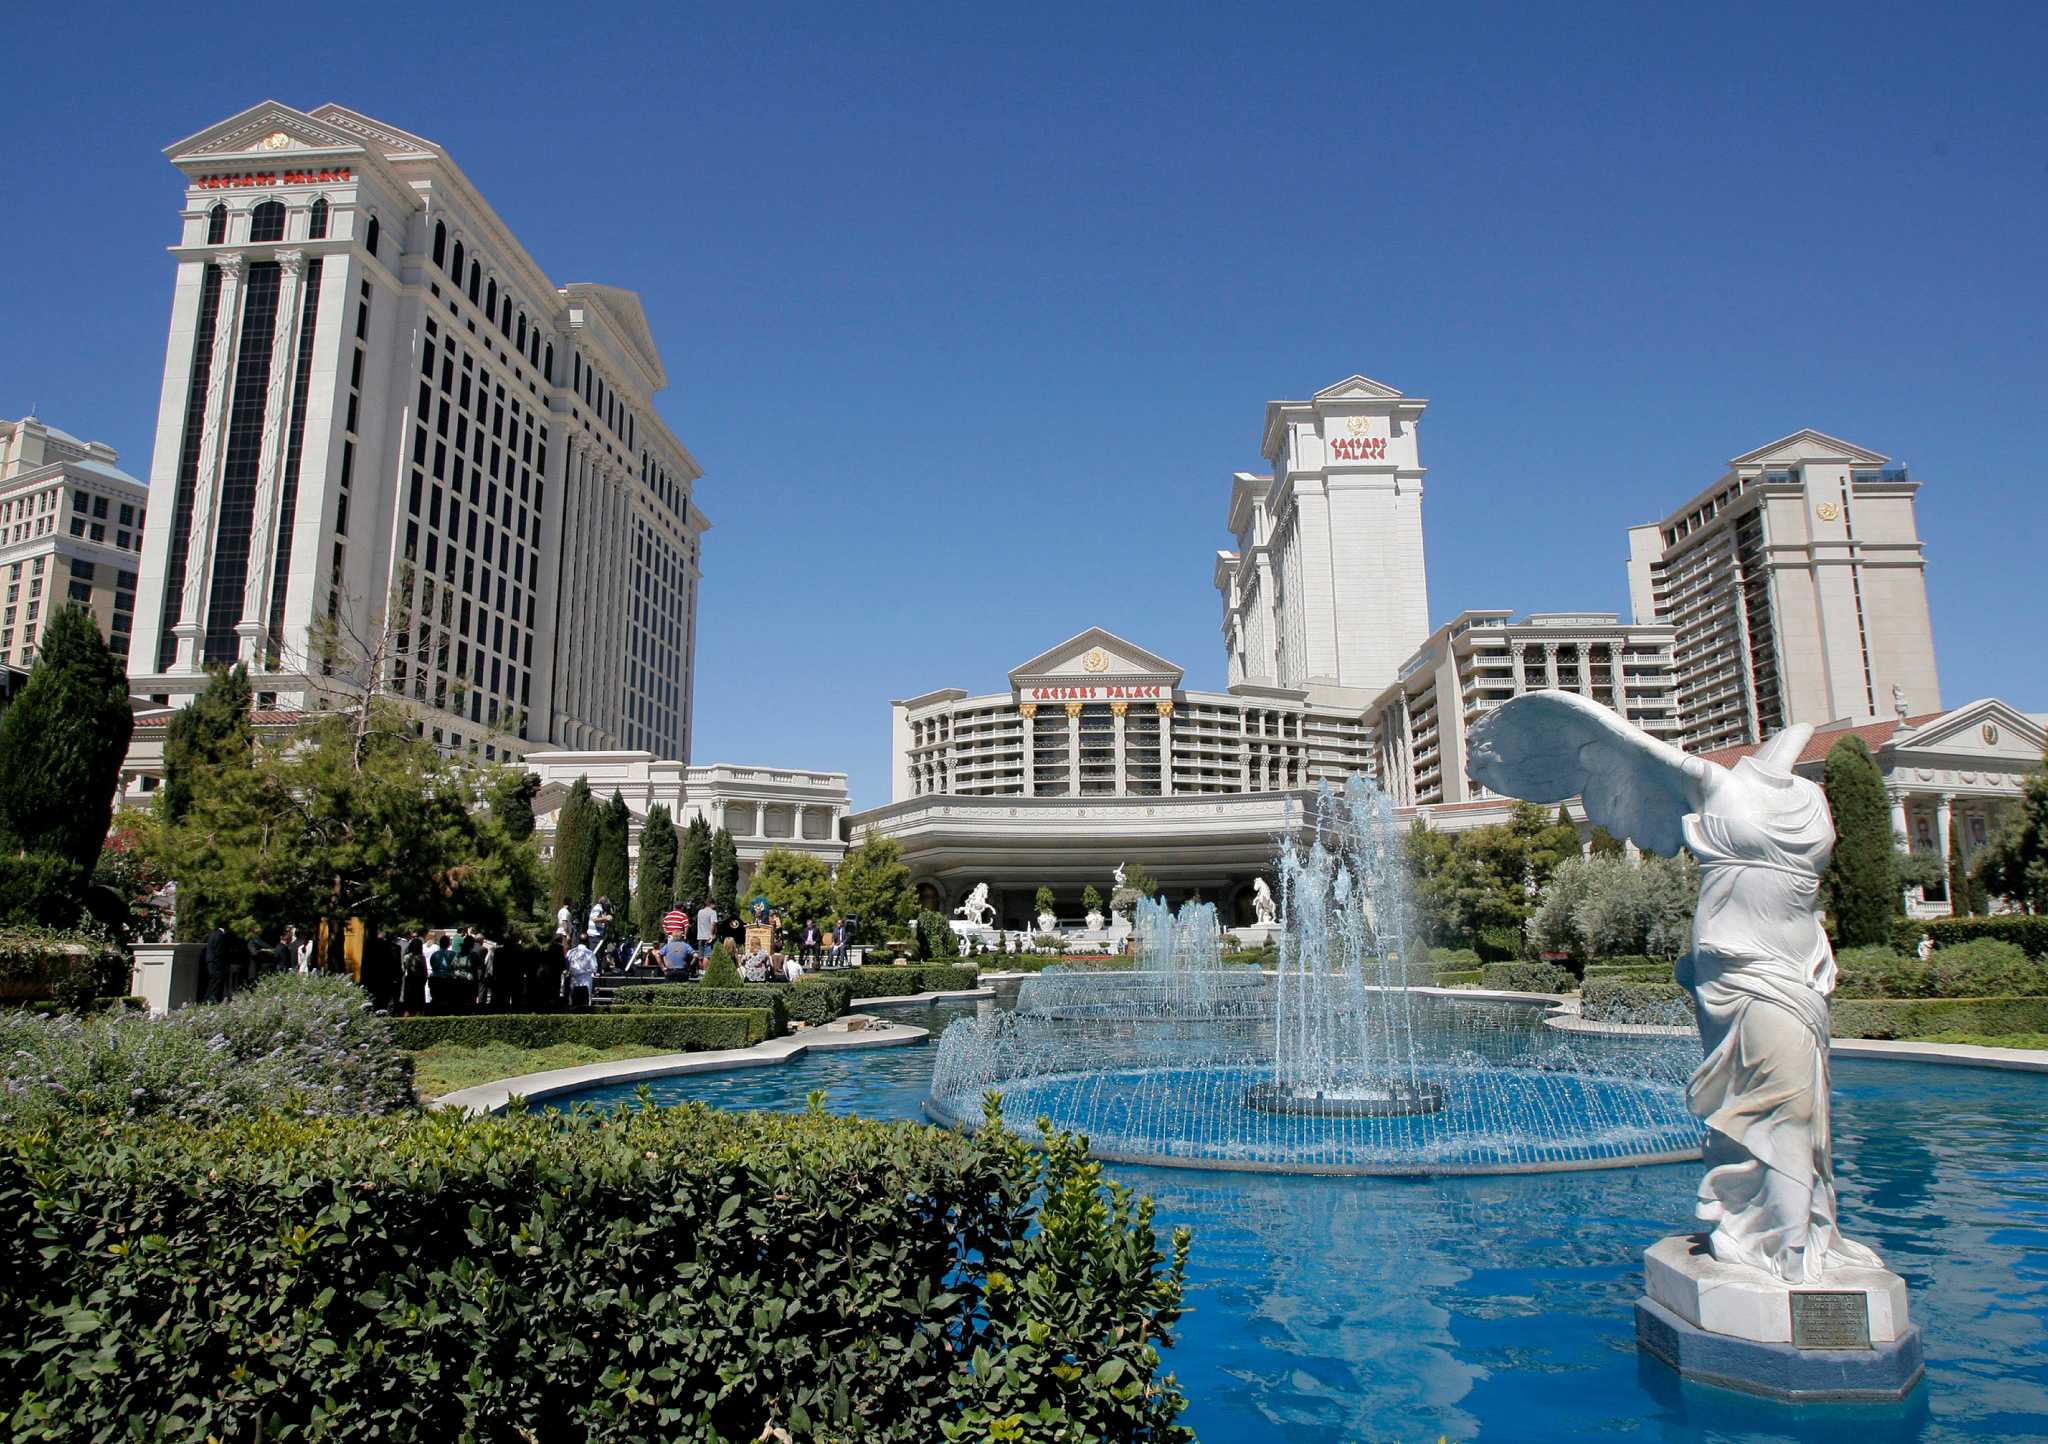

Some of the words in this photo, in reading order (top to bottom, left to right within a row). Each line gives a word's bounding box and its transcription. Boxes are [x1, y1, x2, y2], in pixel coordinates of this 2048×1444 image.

[198, 172, 276, 190] CAESARS
[283, 167, 351, 185] PALACE
[1330, 437, 1388, 449] CAESARS
[1334, 448, 1385, 460] PALACE
[1031, 687, 1097, 700] CAESARS
[1106, 686, 1161, 699] PALACE
